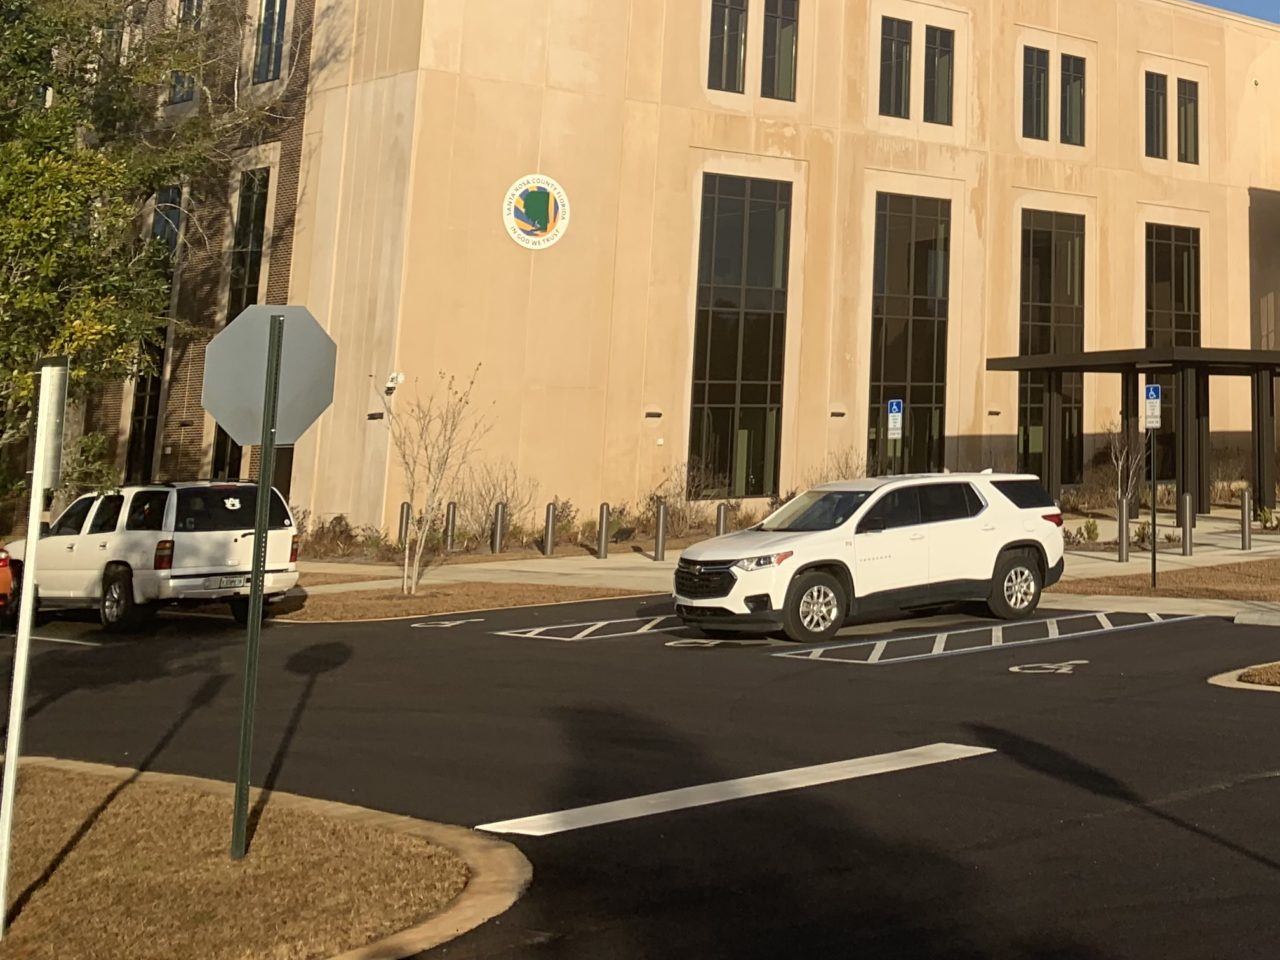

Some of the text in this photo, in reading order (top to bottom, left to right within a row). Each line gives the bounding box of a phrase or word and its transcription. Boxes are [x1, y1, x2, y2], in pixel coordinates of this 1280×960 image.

[506, 192, 516, 216] SANTA
[531, 177, 558, 191] COUNTY
[556, 191, 567, 221] FLORIDA
[516, 233, 530, 244] GOD
[542, 228, 560, 244] TRUST
